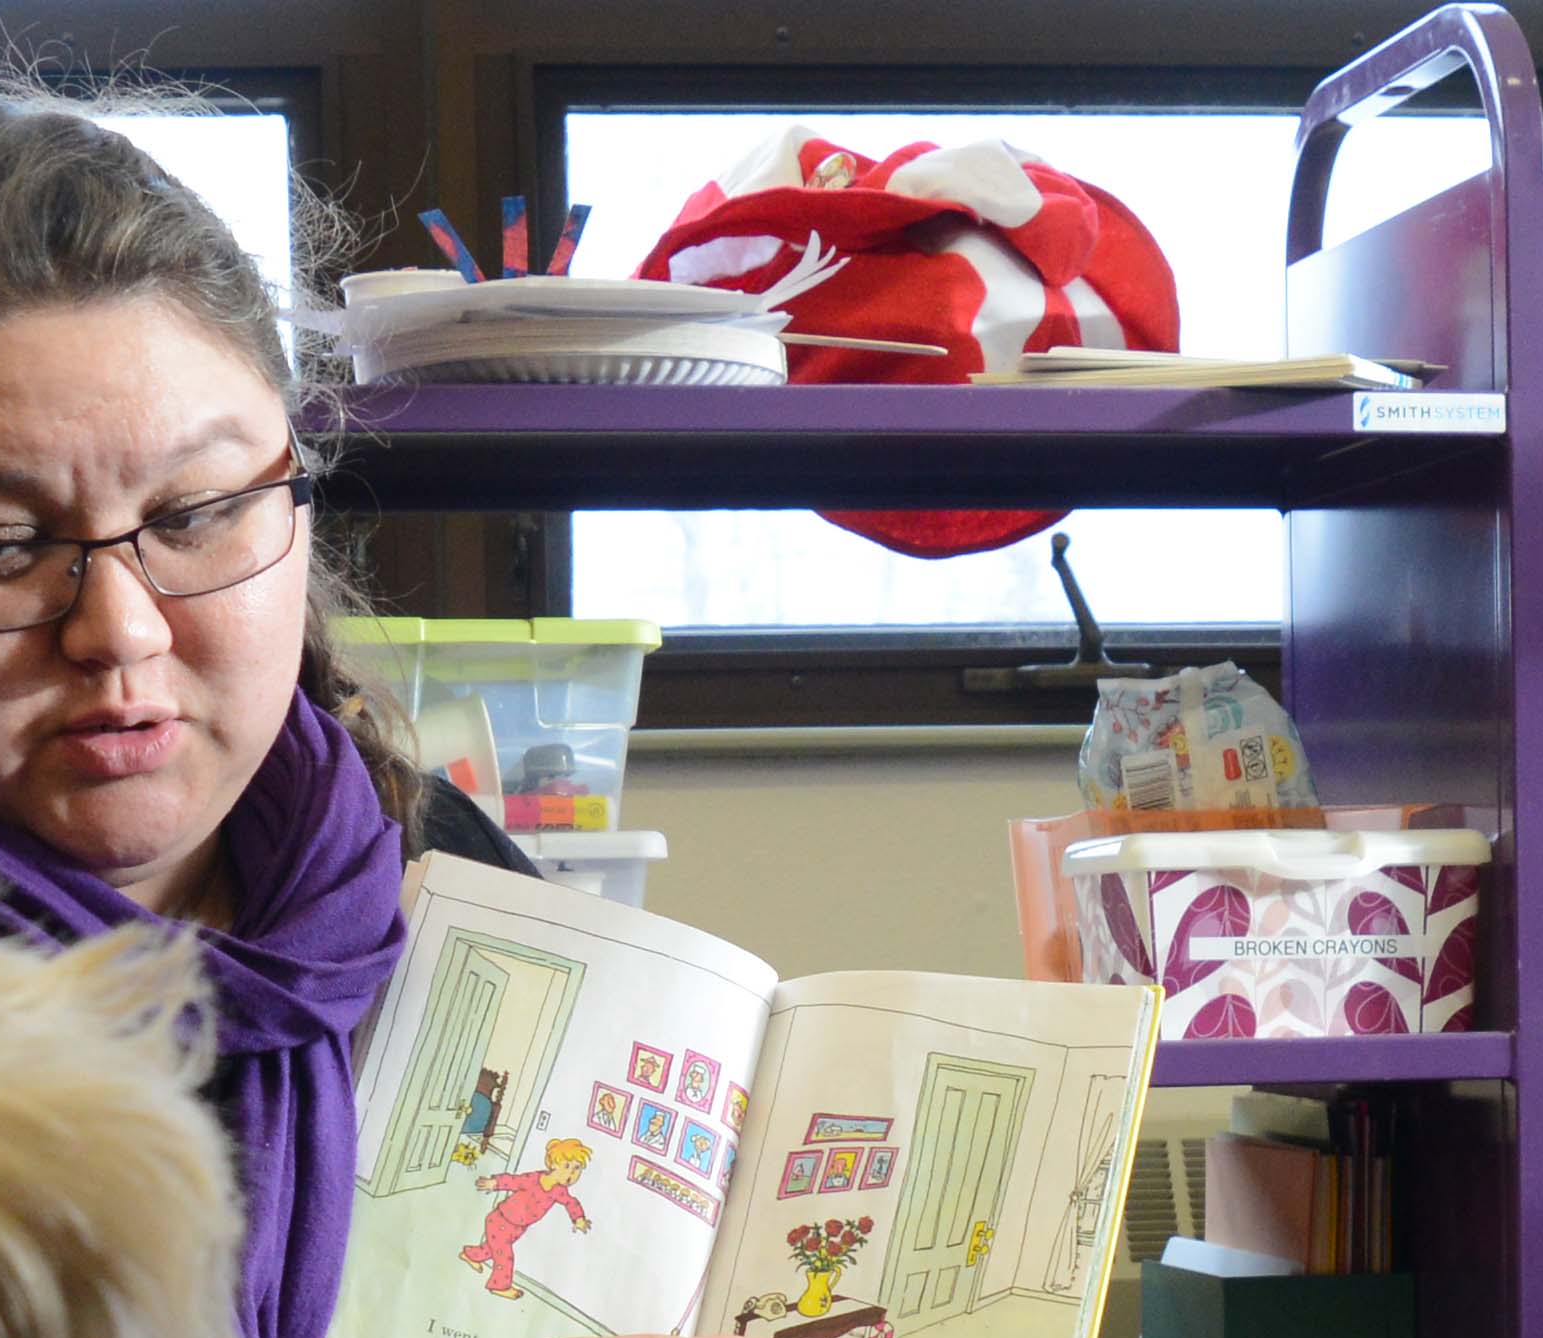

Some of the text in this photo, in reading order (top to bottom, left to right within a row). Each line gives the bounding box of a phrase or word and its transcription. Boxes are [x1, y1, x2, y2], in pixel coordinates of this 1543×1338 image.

[1234, 939, 1398, 957] BROKEN CRAYONS
[427, 1319, 436, 1333] I
